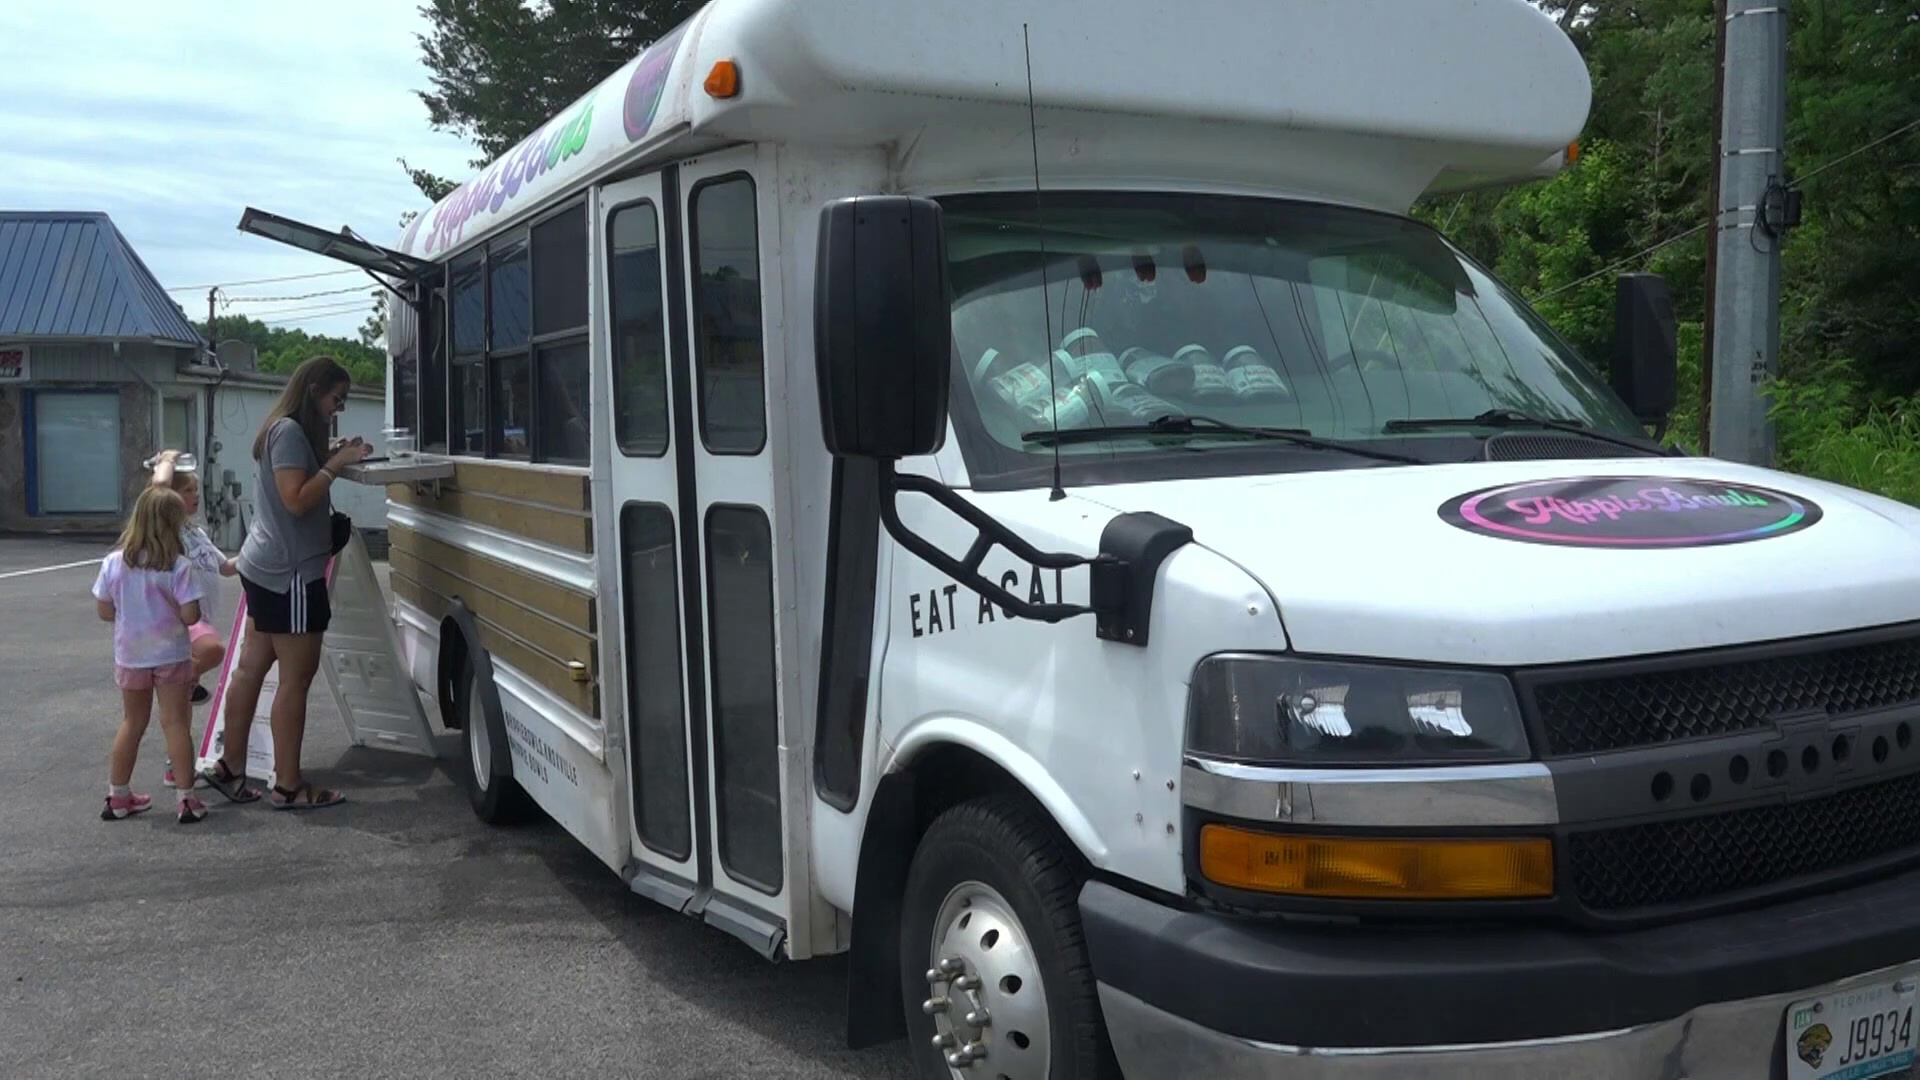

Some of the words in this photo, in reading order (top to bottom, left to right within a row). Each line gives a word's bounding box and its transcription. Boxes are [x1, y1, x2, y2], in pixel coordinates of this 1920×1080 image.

[1505, 495, 1645, 525] Hippie
[1638, 486, 1770, 512] Bowls
[910, 584, 958, 638] EAT
[1840, 1005, 1913, 1065] J9934
